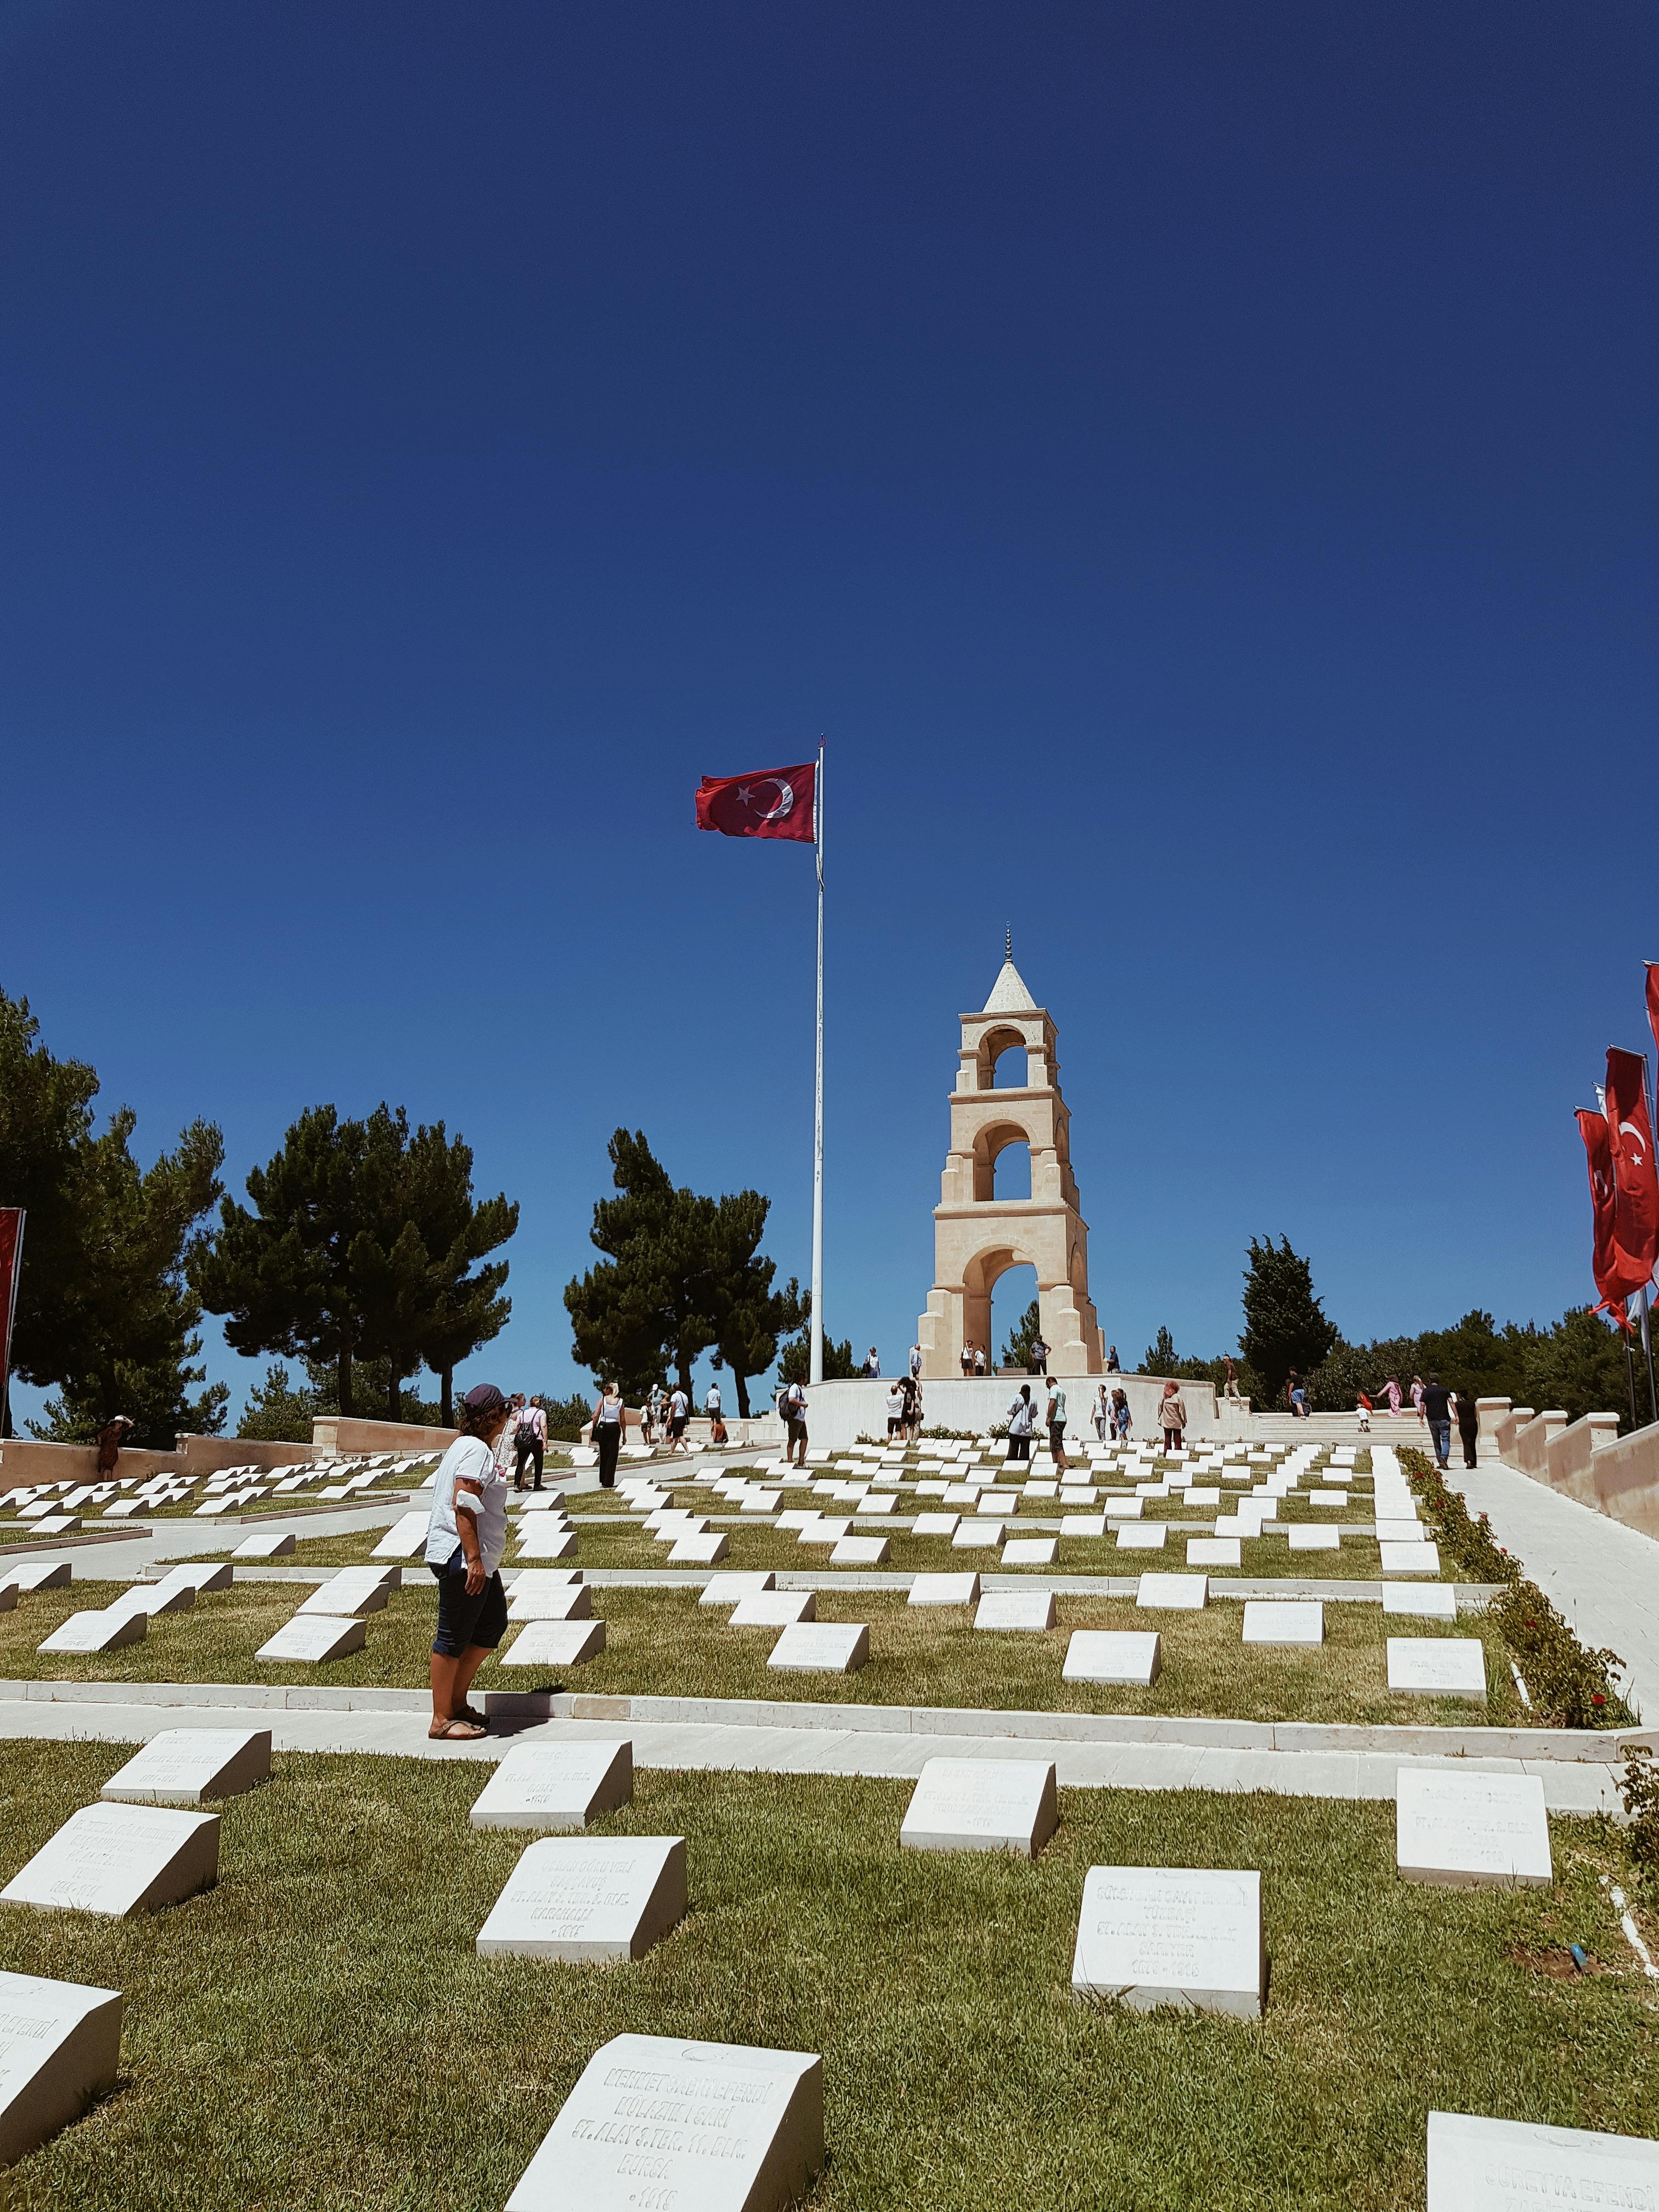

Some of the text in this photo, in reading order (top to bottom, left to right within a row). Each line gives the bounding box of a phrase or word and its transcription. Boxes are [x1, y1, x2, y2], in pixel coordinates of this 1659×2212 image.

[603, 2068, 670, 2092] MEHMET
[713, 2081, 774, 2105] EFENDİ
[616, 2153, 674, 2180] BURSA
